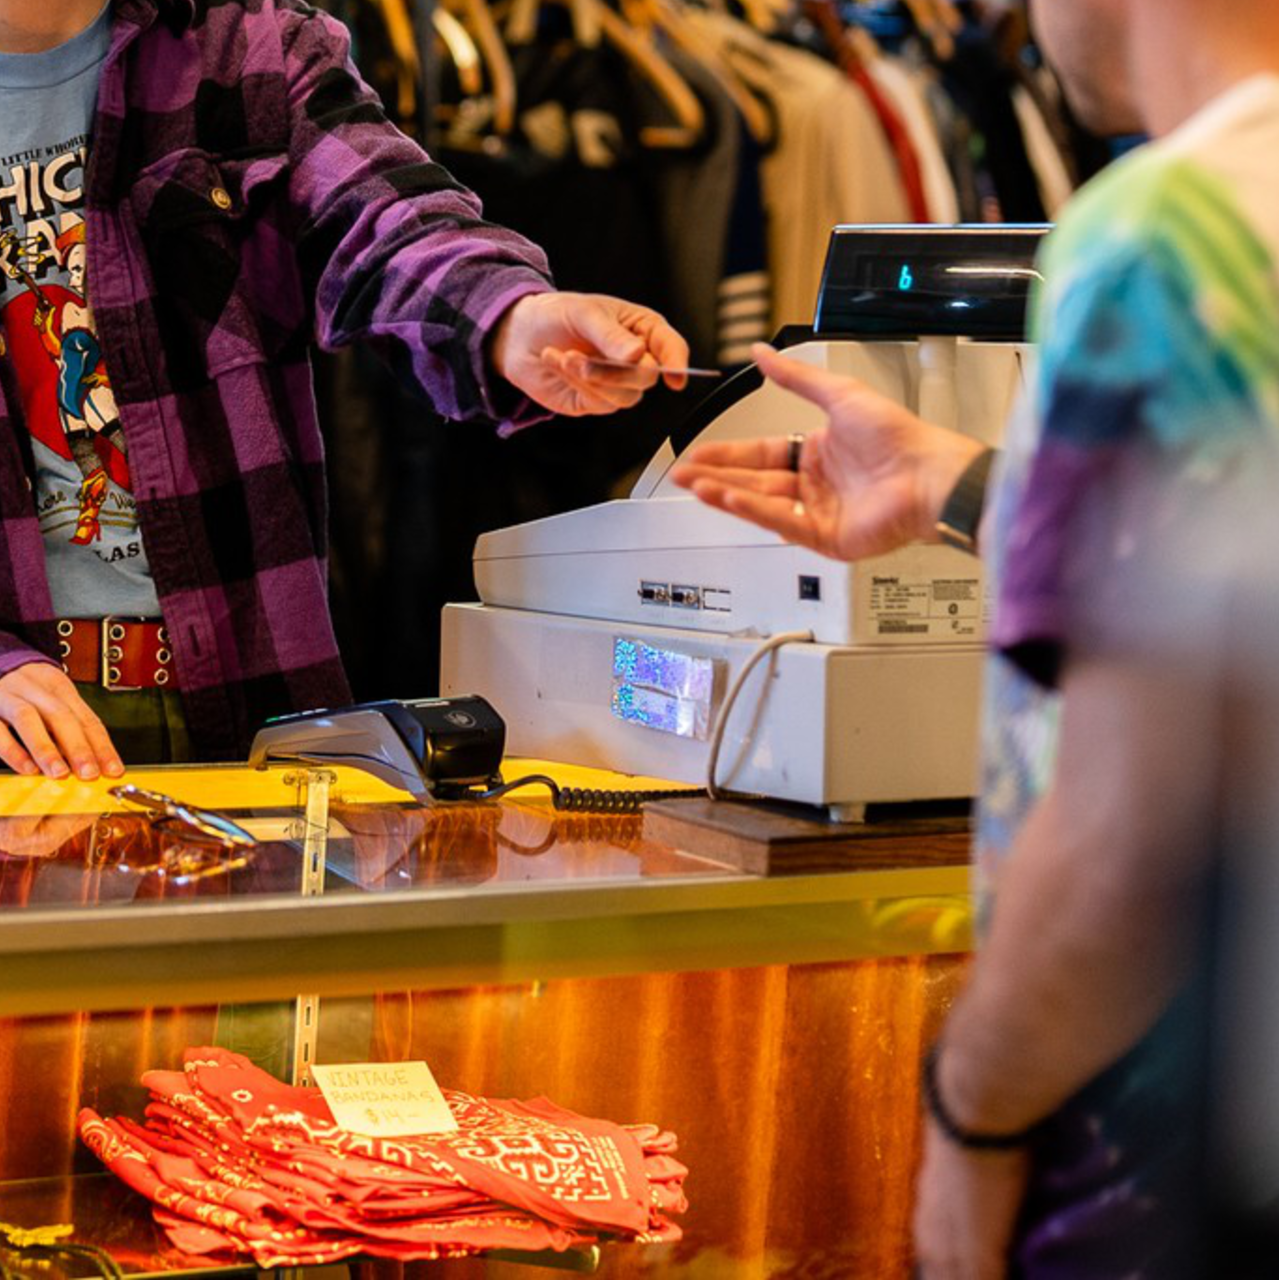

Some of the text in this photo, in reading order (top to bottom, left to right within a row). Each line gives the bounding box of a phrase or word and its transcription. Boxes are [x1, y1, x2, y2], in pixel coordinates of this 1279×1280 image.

[1, 147, 42, 166] LITTLE
[327, 1069, 408, 1087] VINTAGE
[330, 1090, 435, 1104] BANDANAS
